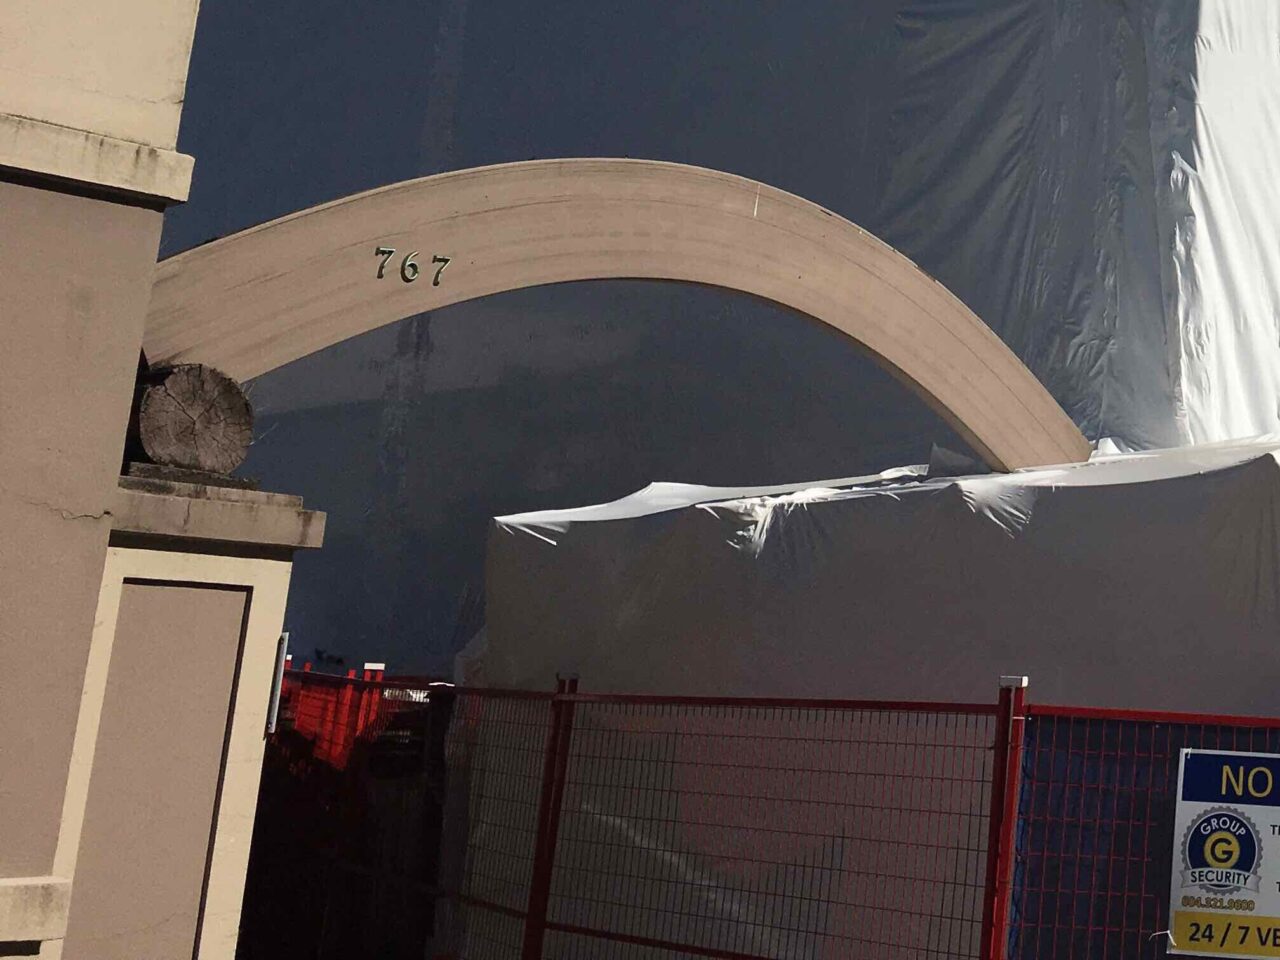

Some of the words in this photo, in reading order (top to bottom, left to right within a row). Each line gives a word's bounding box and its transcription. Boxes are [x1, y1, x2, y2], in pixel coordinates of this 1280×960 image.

[375, 247, 450, 286] 767
[1221, 765, 1273, 798] NO
[1200, 817, 1246, 836] GROUP
[1210, 837, 1233, 863] G
[1190, 870, 1250, 886] SECURITY
[1189, 922, 1214, 942] 24
[1219, 922, 1232, 948] /
[1238, 926, 1250, 945] 7
